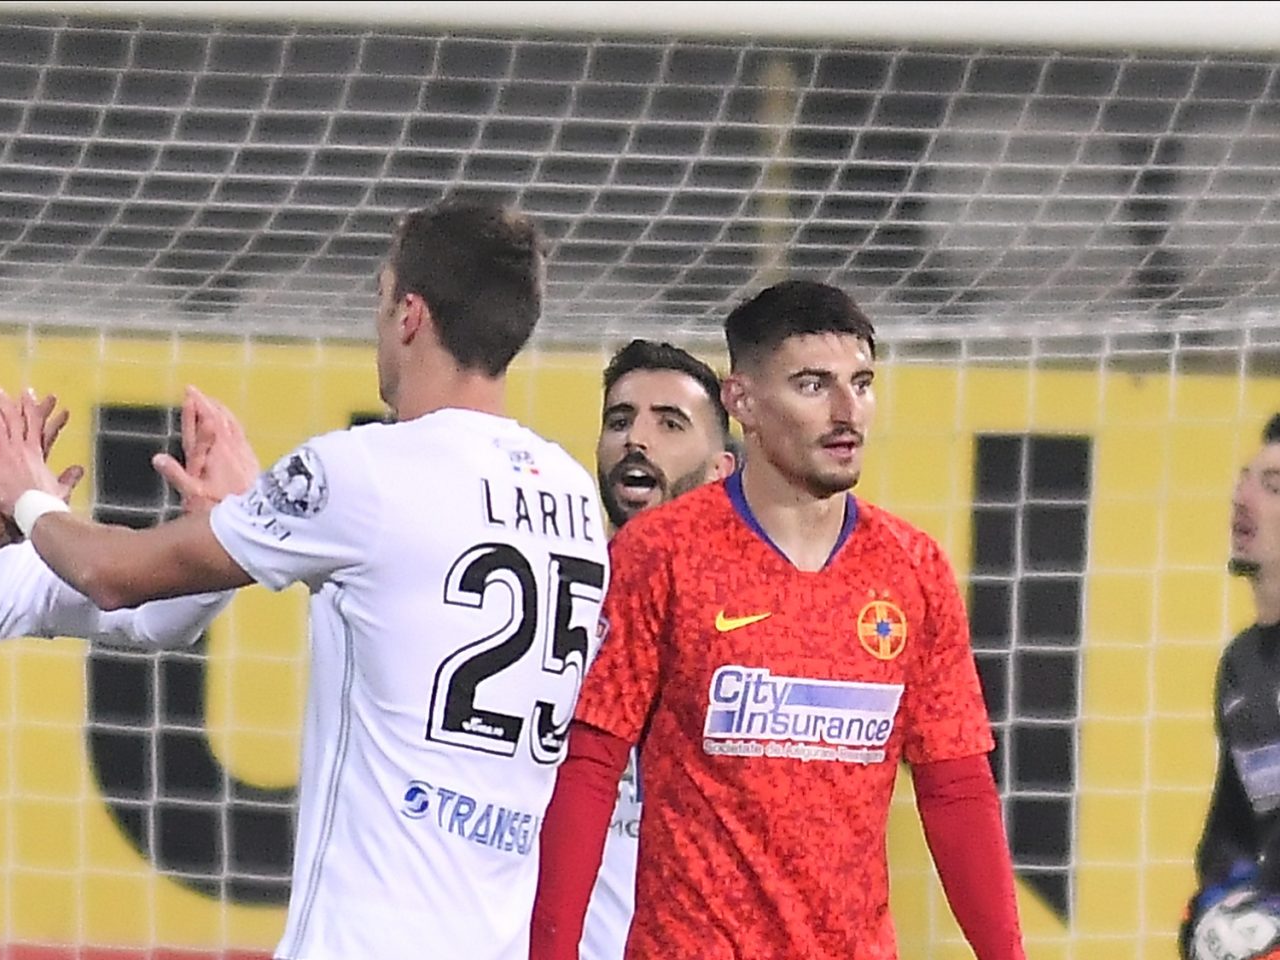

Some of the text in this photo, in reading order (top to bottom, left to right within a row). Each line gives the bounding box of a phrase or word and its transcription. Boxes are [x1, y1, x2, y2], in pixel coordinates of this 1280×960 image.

[481, 478, 594, 542] LARIE
[425, 543, 605, 765] 25
[713, 669, 789, 715] City
[735, 700, 891, 742] Insurance
